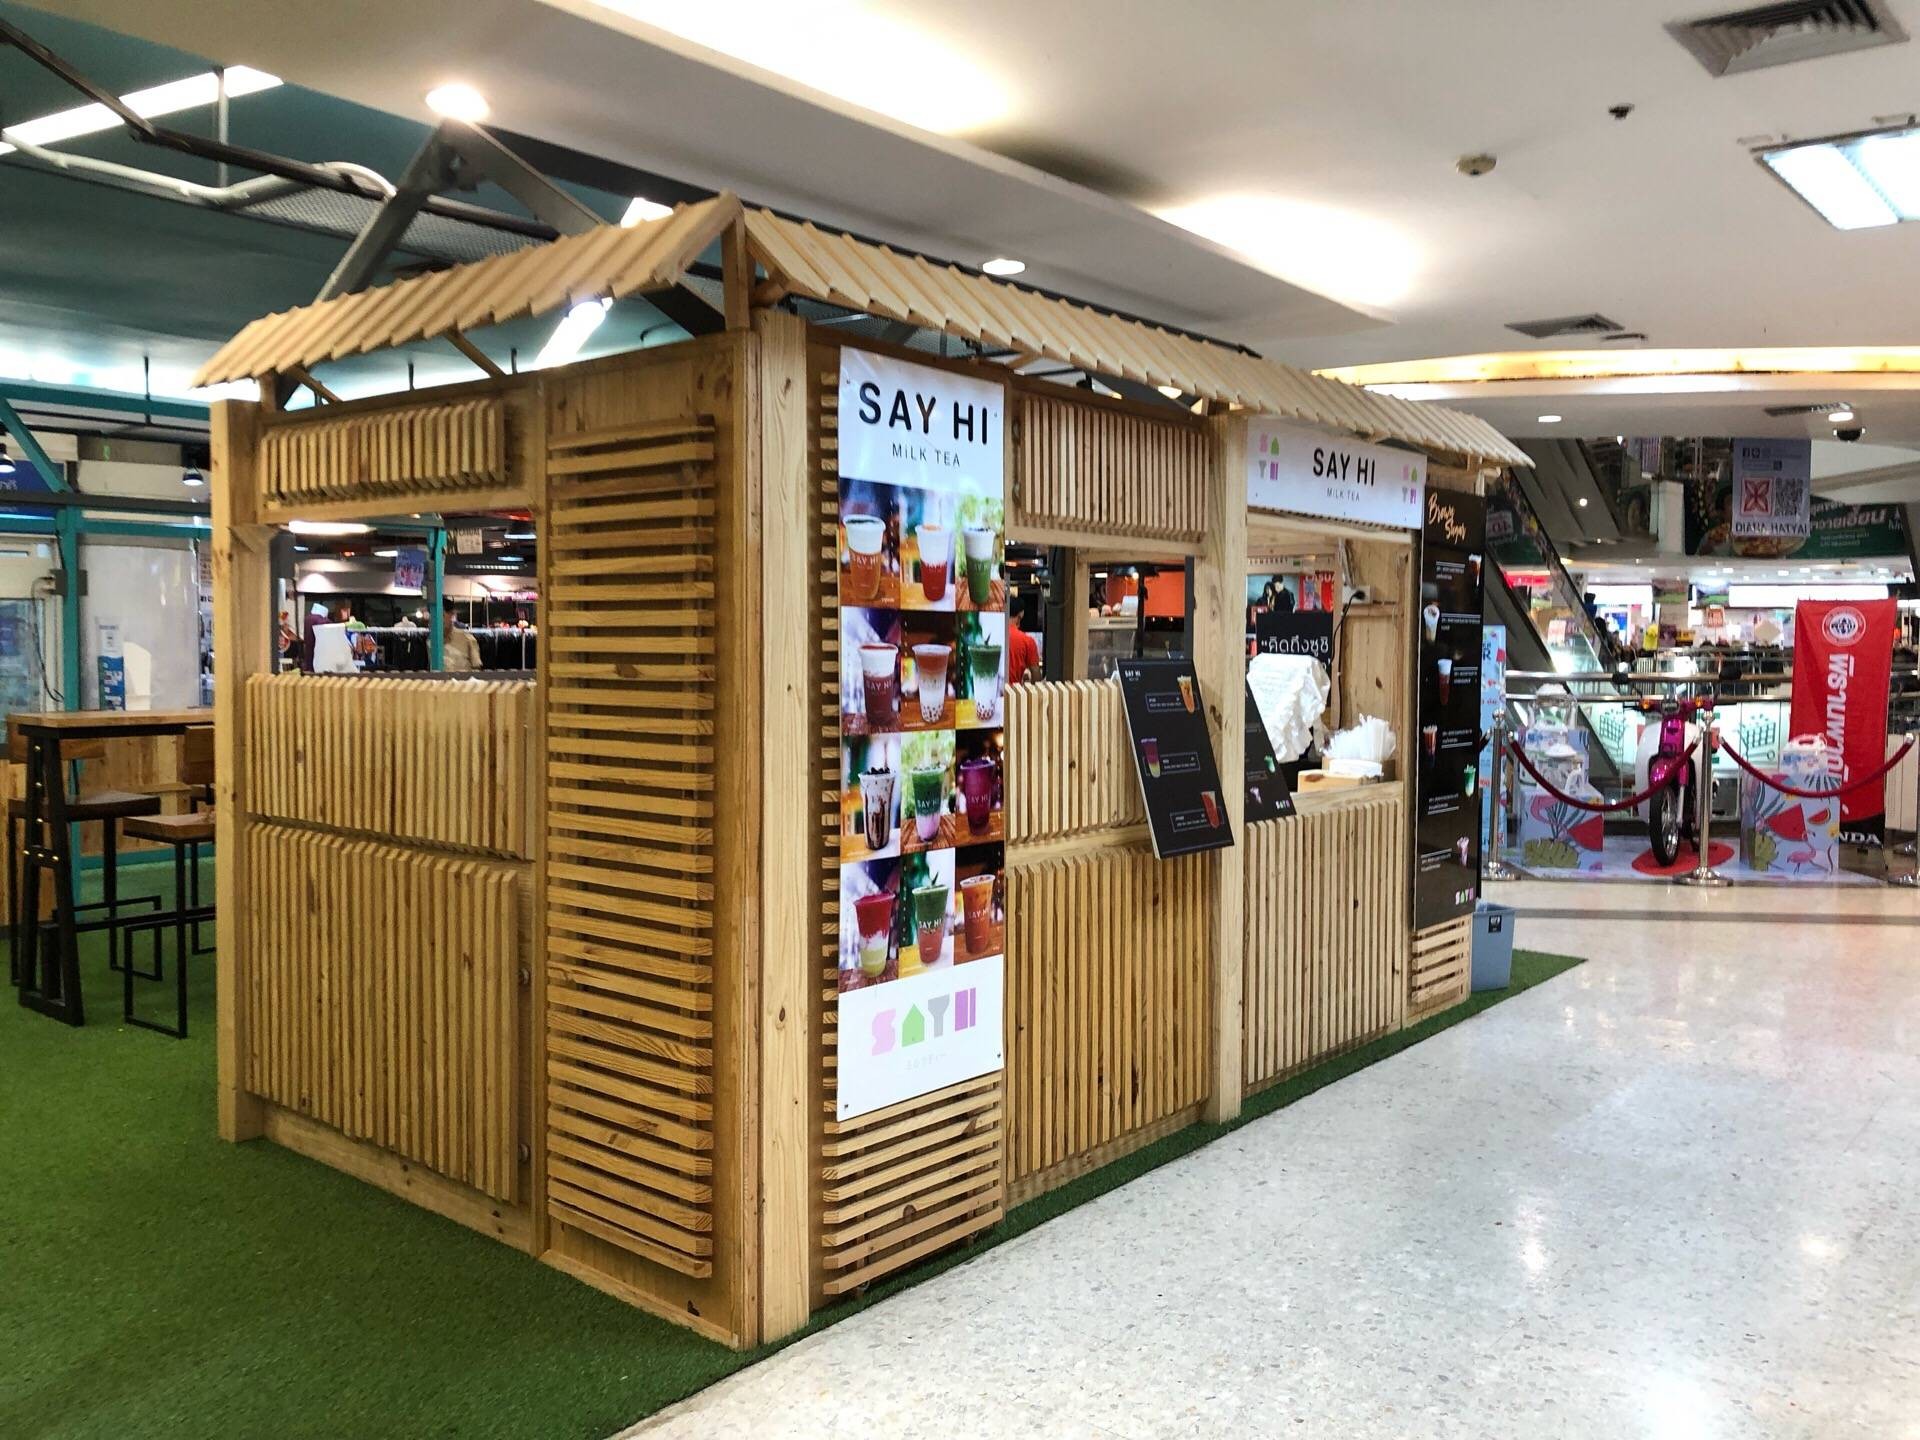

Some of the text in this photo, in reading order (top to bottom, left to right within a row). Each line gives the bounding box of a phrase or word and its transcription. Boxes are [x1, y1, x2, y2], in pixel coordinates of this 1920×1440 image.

[859, 381, 988, 445] SAY HI
[892, 443, 961, 468] MILK TEA
[1313, 447, 1376, 487] SAY HI
[1327, 487, 1360, 502] MILK TEA
[1839, 831, 1881, 844] NDA
